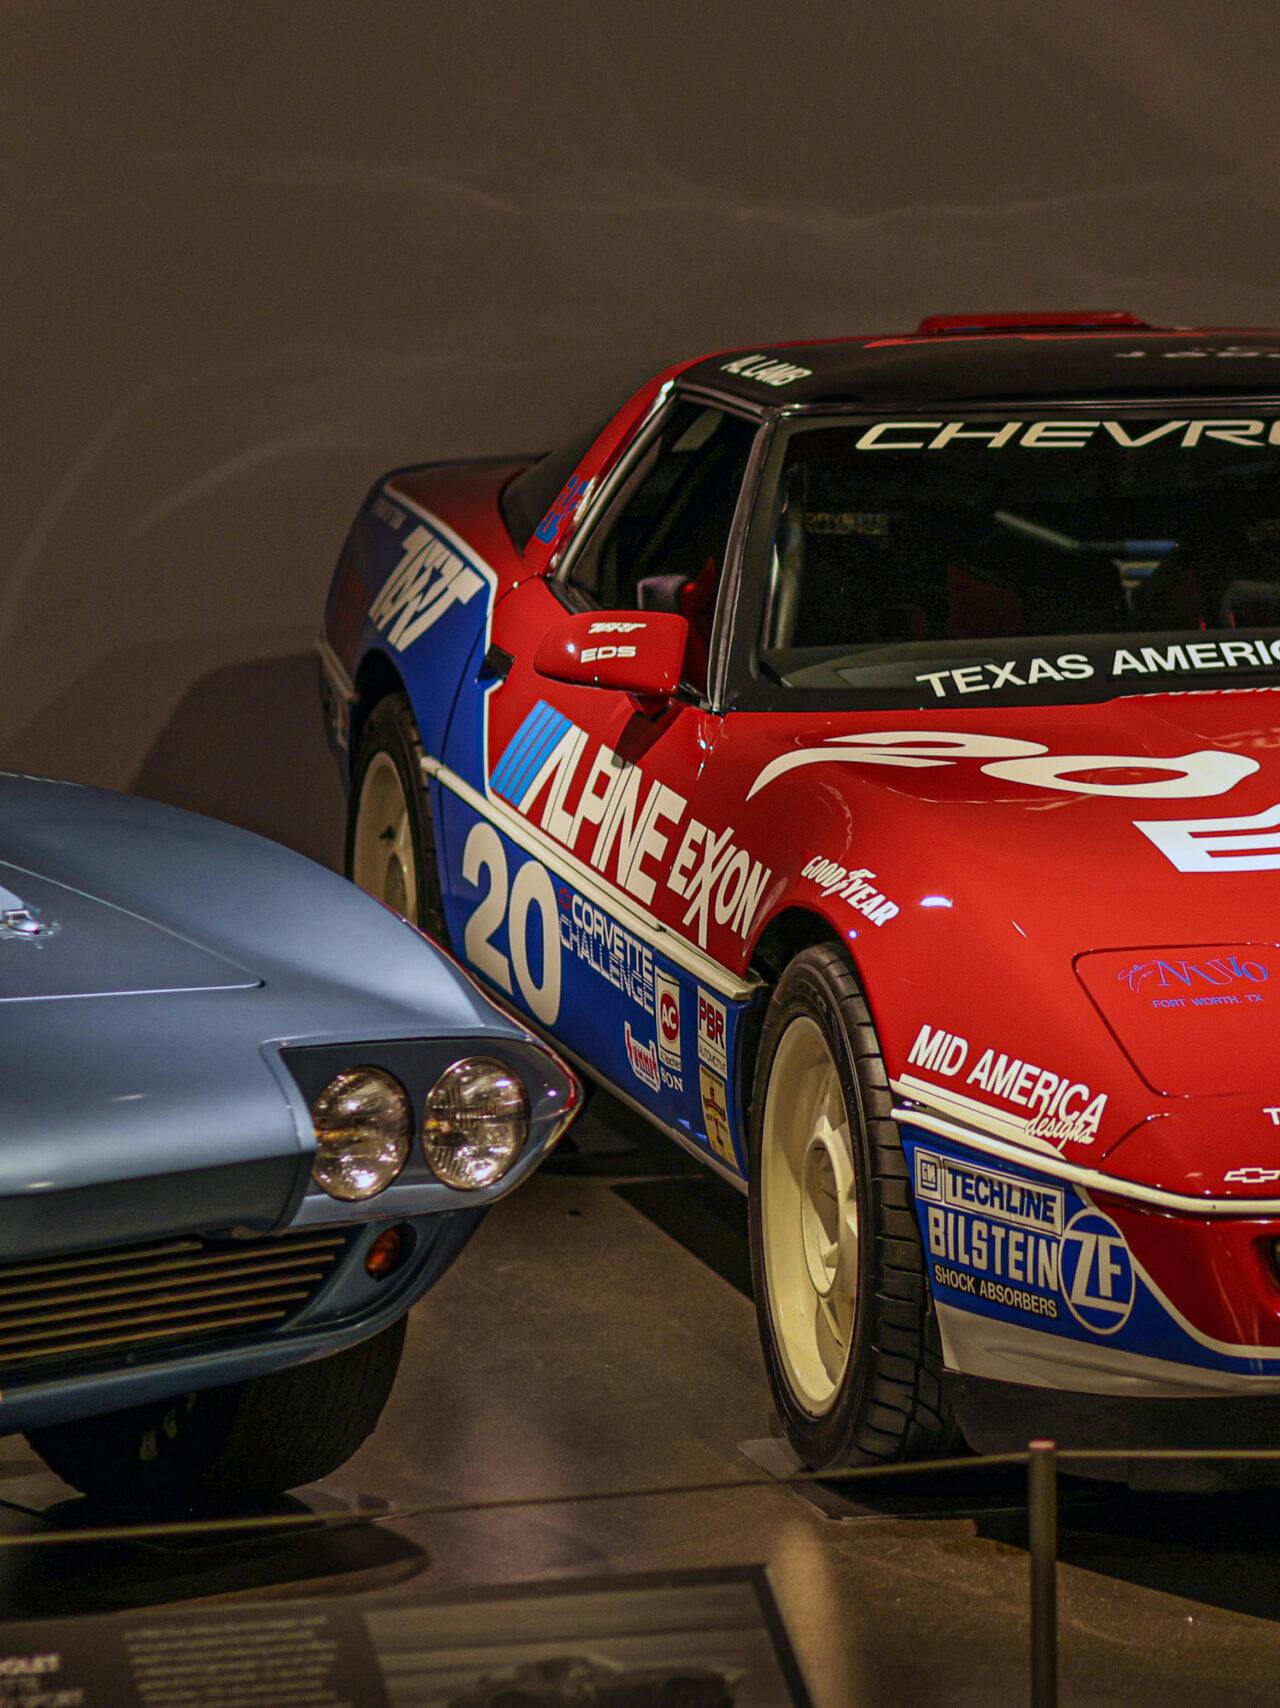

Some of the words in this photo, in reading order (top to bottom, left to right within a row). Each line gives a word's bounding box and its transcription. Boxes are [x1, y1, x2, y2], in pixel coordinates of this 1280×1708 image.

[581, 646, 636, 664] EDS
[916, 653, 1094, 698] TEXAS
[519, 724, 687, 907] ALPINE
[667, 818, 772, 950] EXXON
[462, 821, 562, 1027] 20
[572, 894, 654, 984] CORVETTE
[560, 914, 655, 1017] CHALLENGE
[1152, 998, 1186, 1008] FORT
[1245, 993, 1264, 1002] TX
[661, 1007, 678, 1031] AC
[698, 996, 726, 1050] PBR
[908, 1024, 968, 1077] MID
[966, 1048, 1107, 1133] AMERICA
[948, 1168, 1057, 1225] TECHLINE
[928, 1206, 1059, 1292] BILSTEIN
[1062, 1229, 1132, 1315] ZF
[934, 1264, 976, 1295] SHOCK
[979, 1281, 1058, 1318] ABSORBERS
